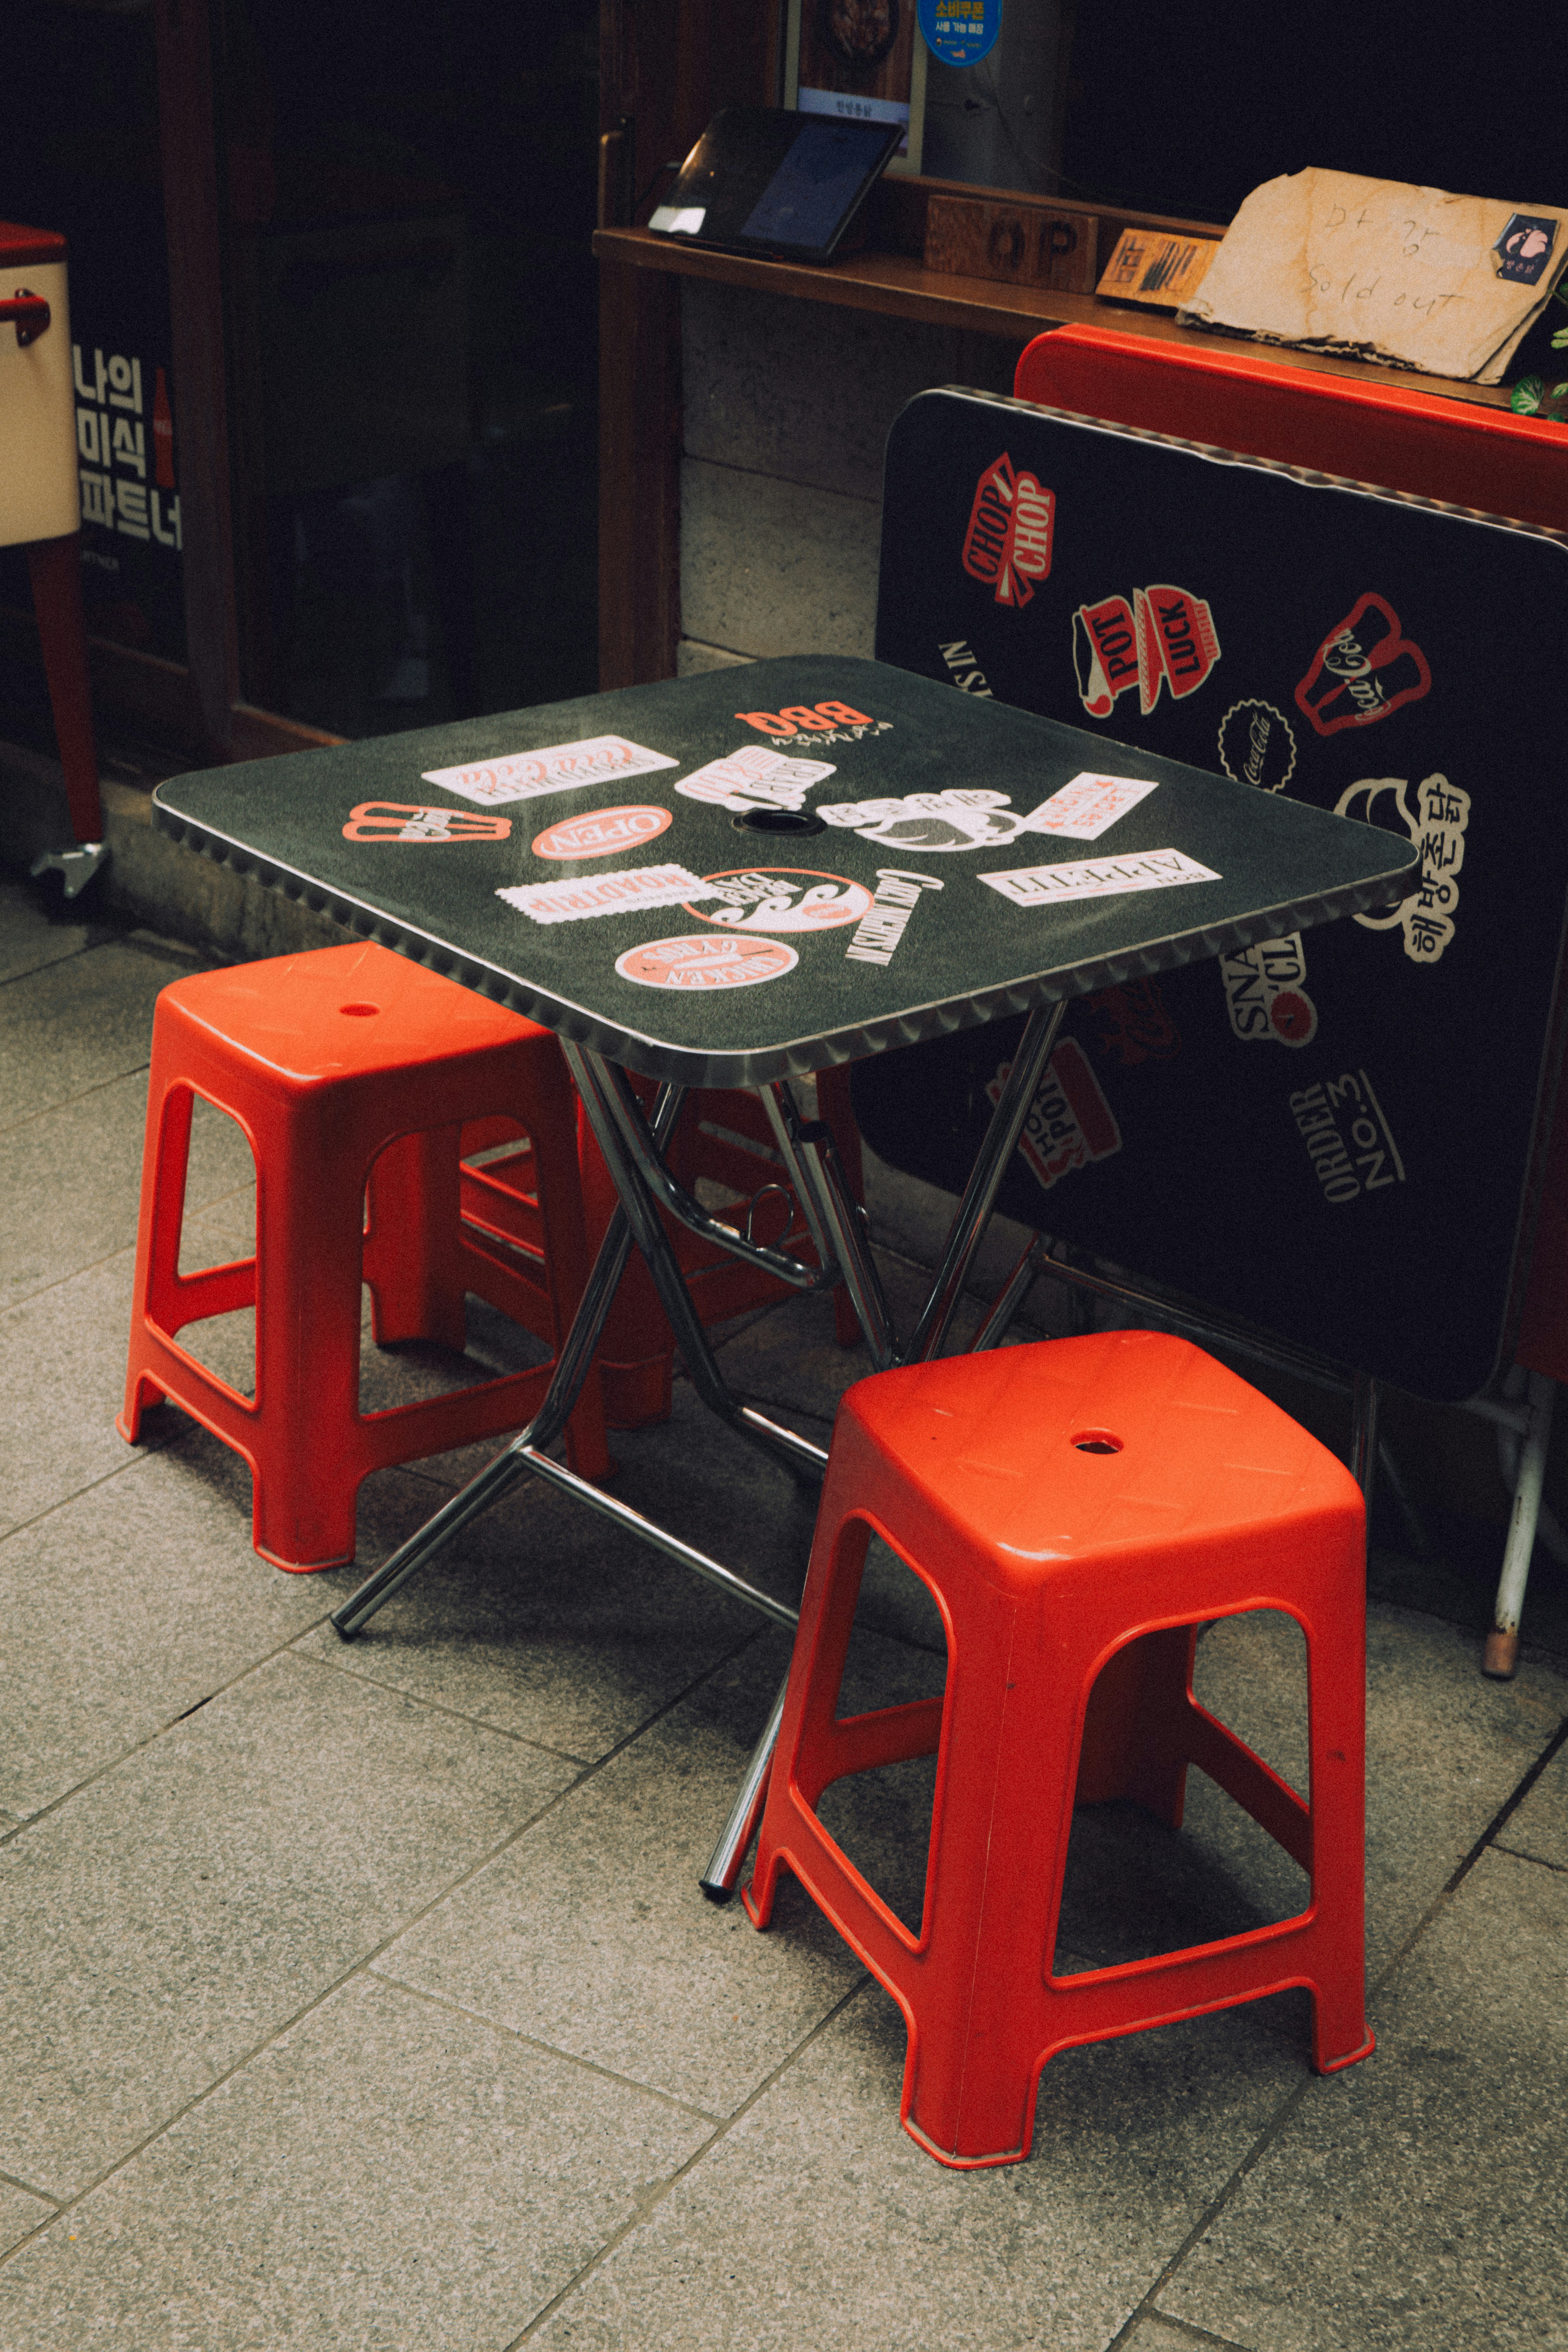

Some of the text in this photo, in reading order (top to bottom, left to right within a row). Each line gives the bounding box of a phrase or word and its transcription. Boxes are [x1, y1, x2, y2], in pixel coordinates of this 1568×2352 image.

[935, 0, 984, 20] 소비쿠폰
[935, 21, 950, 32] 사용
[952, 22, 967, 33] 가능
[1299, 264, 1379, 302] Sold
[73, 344, 143, 414] 나의
[77, 407, 146, 478] 미식
[79, 470, 183, 550] 파트너
[967, 485, 1013, 578] CHOP
[1014, 478, 1051, 574] CHOP
[1096, 612, 1139, 681] POT
[1158, 600, 1201, 676] LUCK
[735, 701, 873, 736] BBQ
[550, 813, 661, 852] OPEN
[528, 873, 693, 913] ROADTRIP
[1411, 783, 1463, 952] 해방촌닭
[642, 940, 739, 963] GYROS
[663, 956, 784, 985] CHICKEN
[1220, 945, 1272, 1038] SNA
[1026, 1109, 1054, 1157] HO
[1290, 1082, 1361, 1203] ORDER
